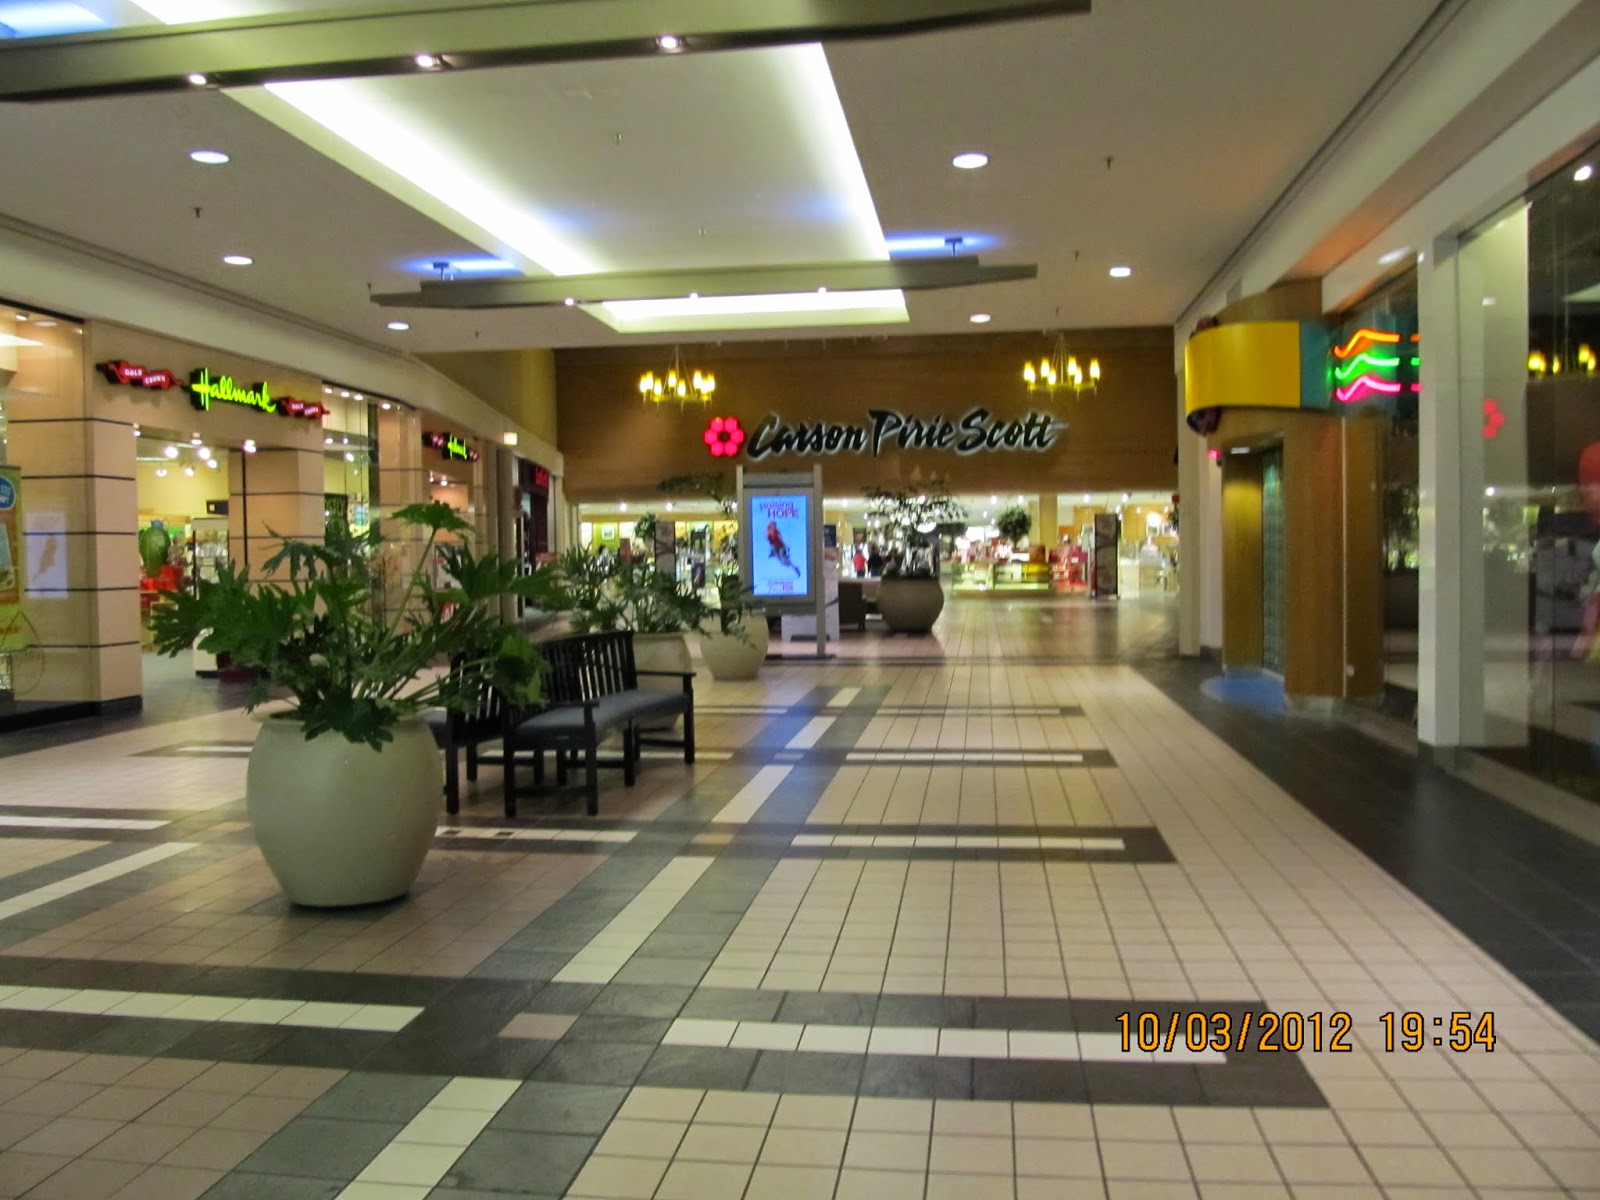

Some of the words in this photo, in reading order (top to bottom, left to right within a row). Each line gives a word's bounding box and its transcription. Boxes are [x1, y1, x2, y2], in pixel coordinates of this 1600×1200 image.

[123, 368, 143, 377] GOLD
[144, 376, 166, 384] CROWN
[192, 367, 276, 412] Hallmark
[747, 412, 869, 462] Carson
[868, 409, 955, 458] Pirie
[954, 406, 1066, 456] Scott
